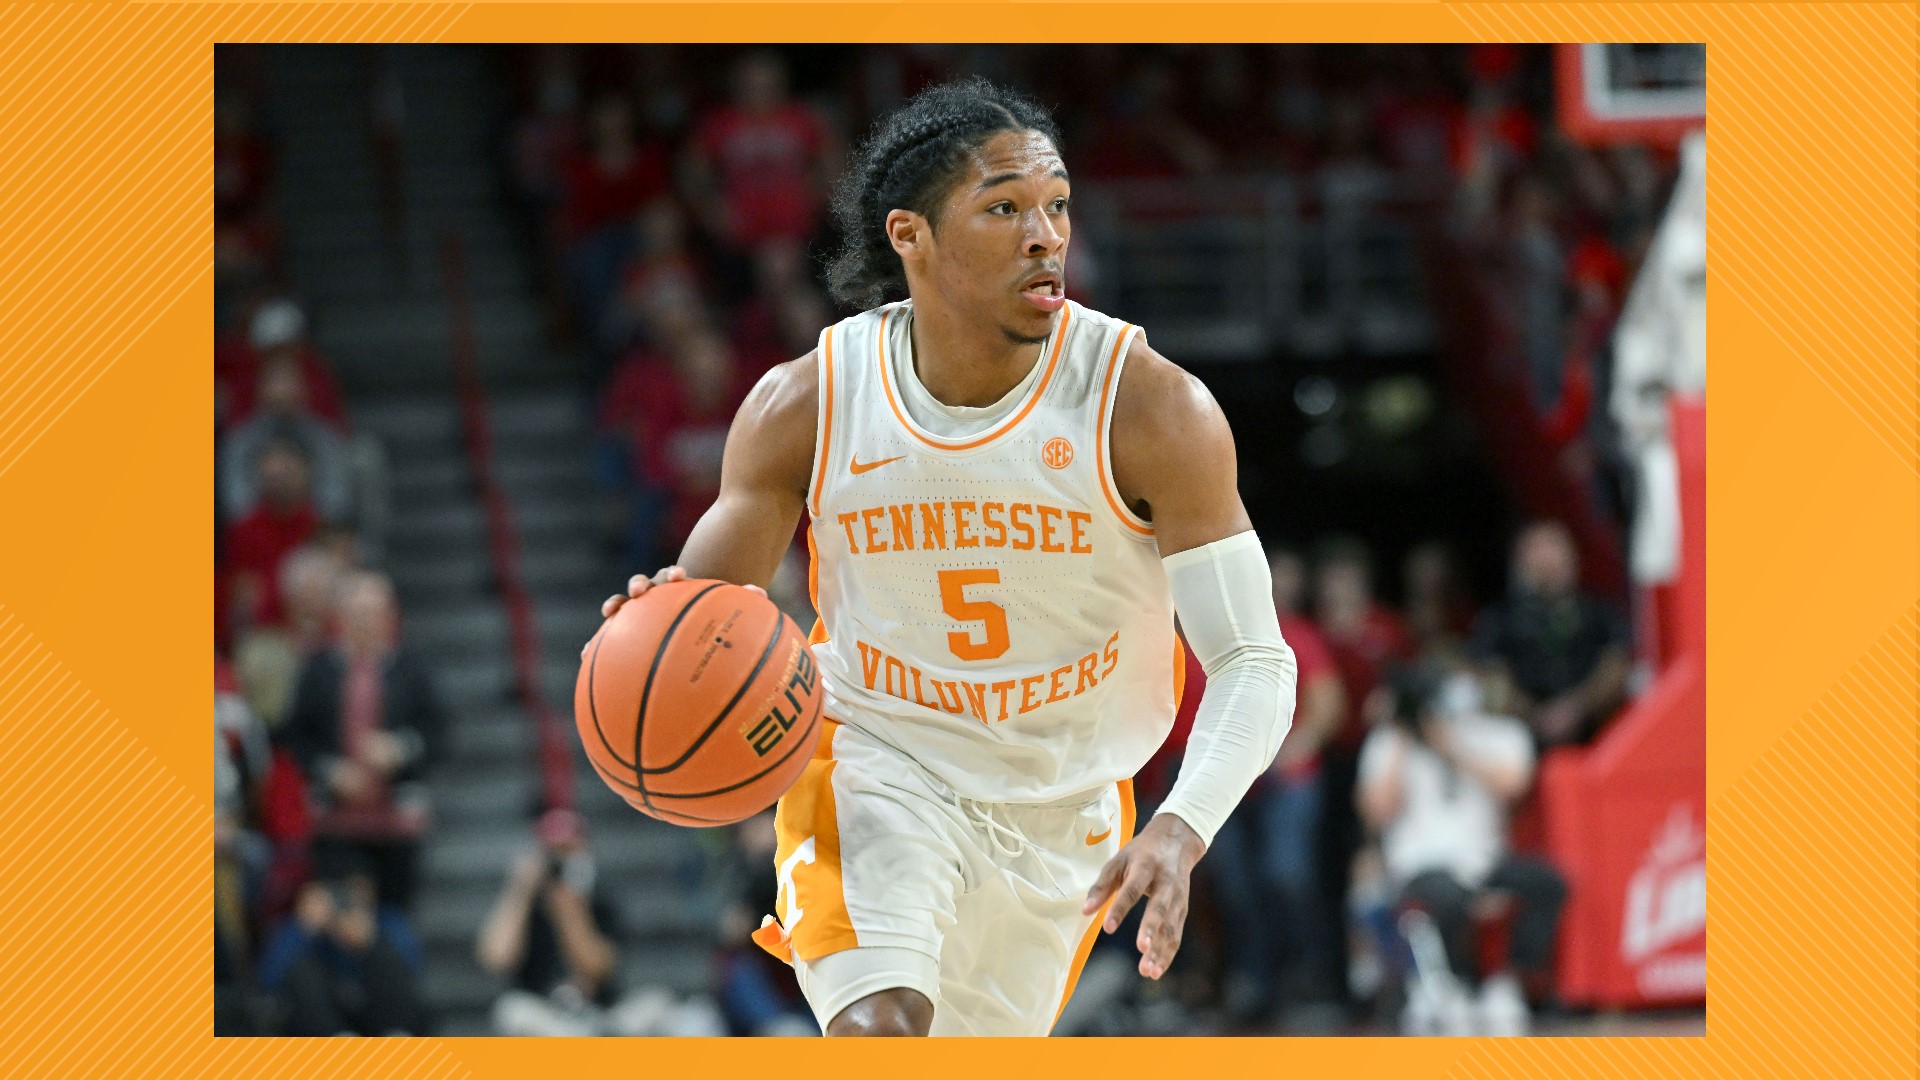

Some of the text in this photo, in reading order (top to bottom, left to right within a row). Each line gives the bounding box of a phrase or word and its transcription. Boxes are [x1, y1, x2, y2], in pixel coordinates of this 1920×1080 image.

[1043, 439, 1072, 467] SEC
[837, 501, 1093, 554] TENNESSEE
[937, 568, 1011, 662] 5
[746, 647, 817, 757] ELITE
[856, 630, 1120, 726] VOLUNTEERS
